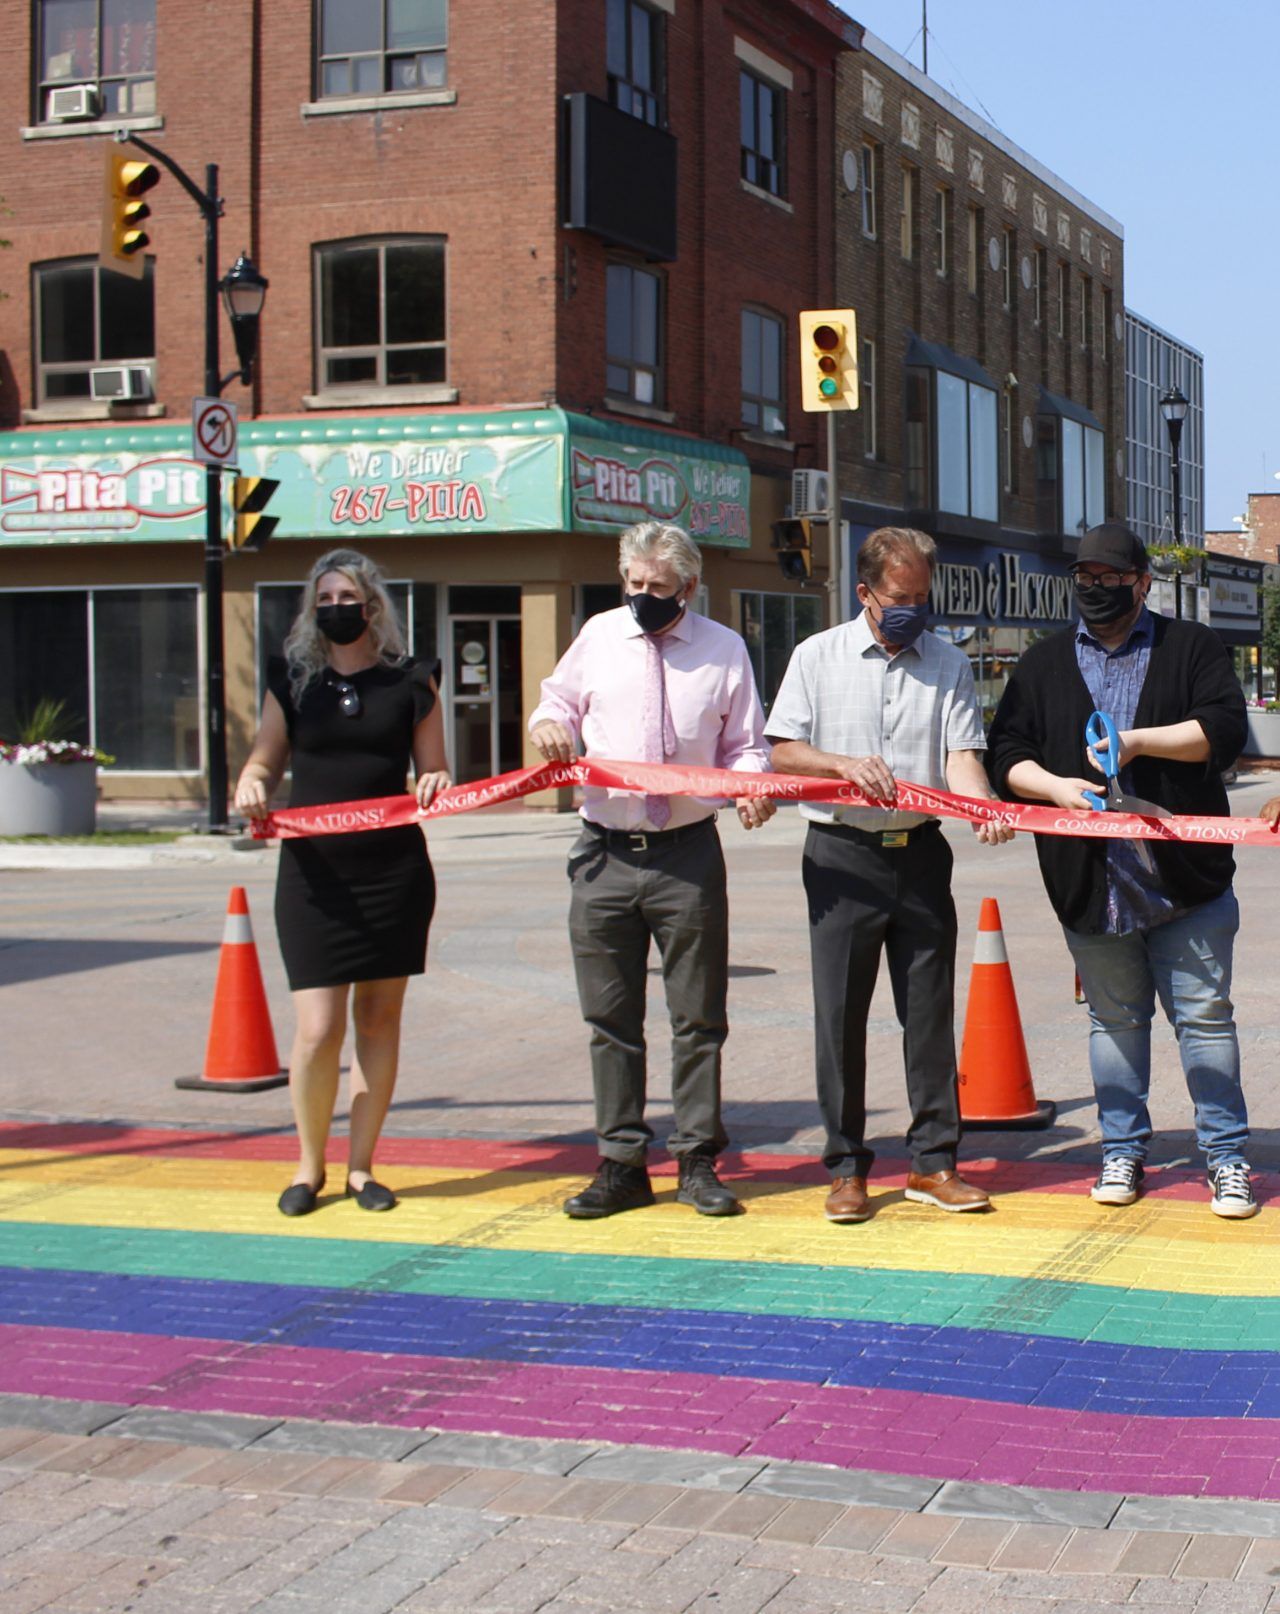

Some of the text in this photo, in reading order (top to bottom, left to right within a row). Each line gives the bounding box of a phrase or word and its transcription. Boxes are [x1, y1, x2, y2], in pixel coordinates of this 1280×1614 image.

[348, 443, 469, 479] We Deliver
[39, 471, 128, 511] Pita
[138, 469, 202, 506] Pit
[331, 480, 487, 525] 267-PITA
[595, 460, 643, 504] Pita
[646, 470, 677, 508] Pit
[931, 553, 1075, 621] WEED & HICKORY
[1053, 816, 1247, 842] CONGRATULATIONS!
